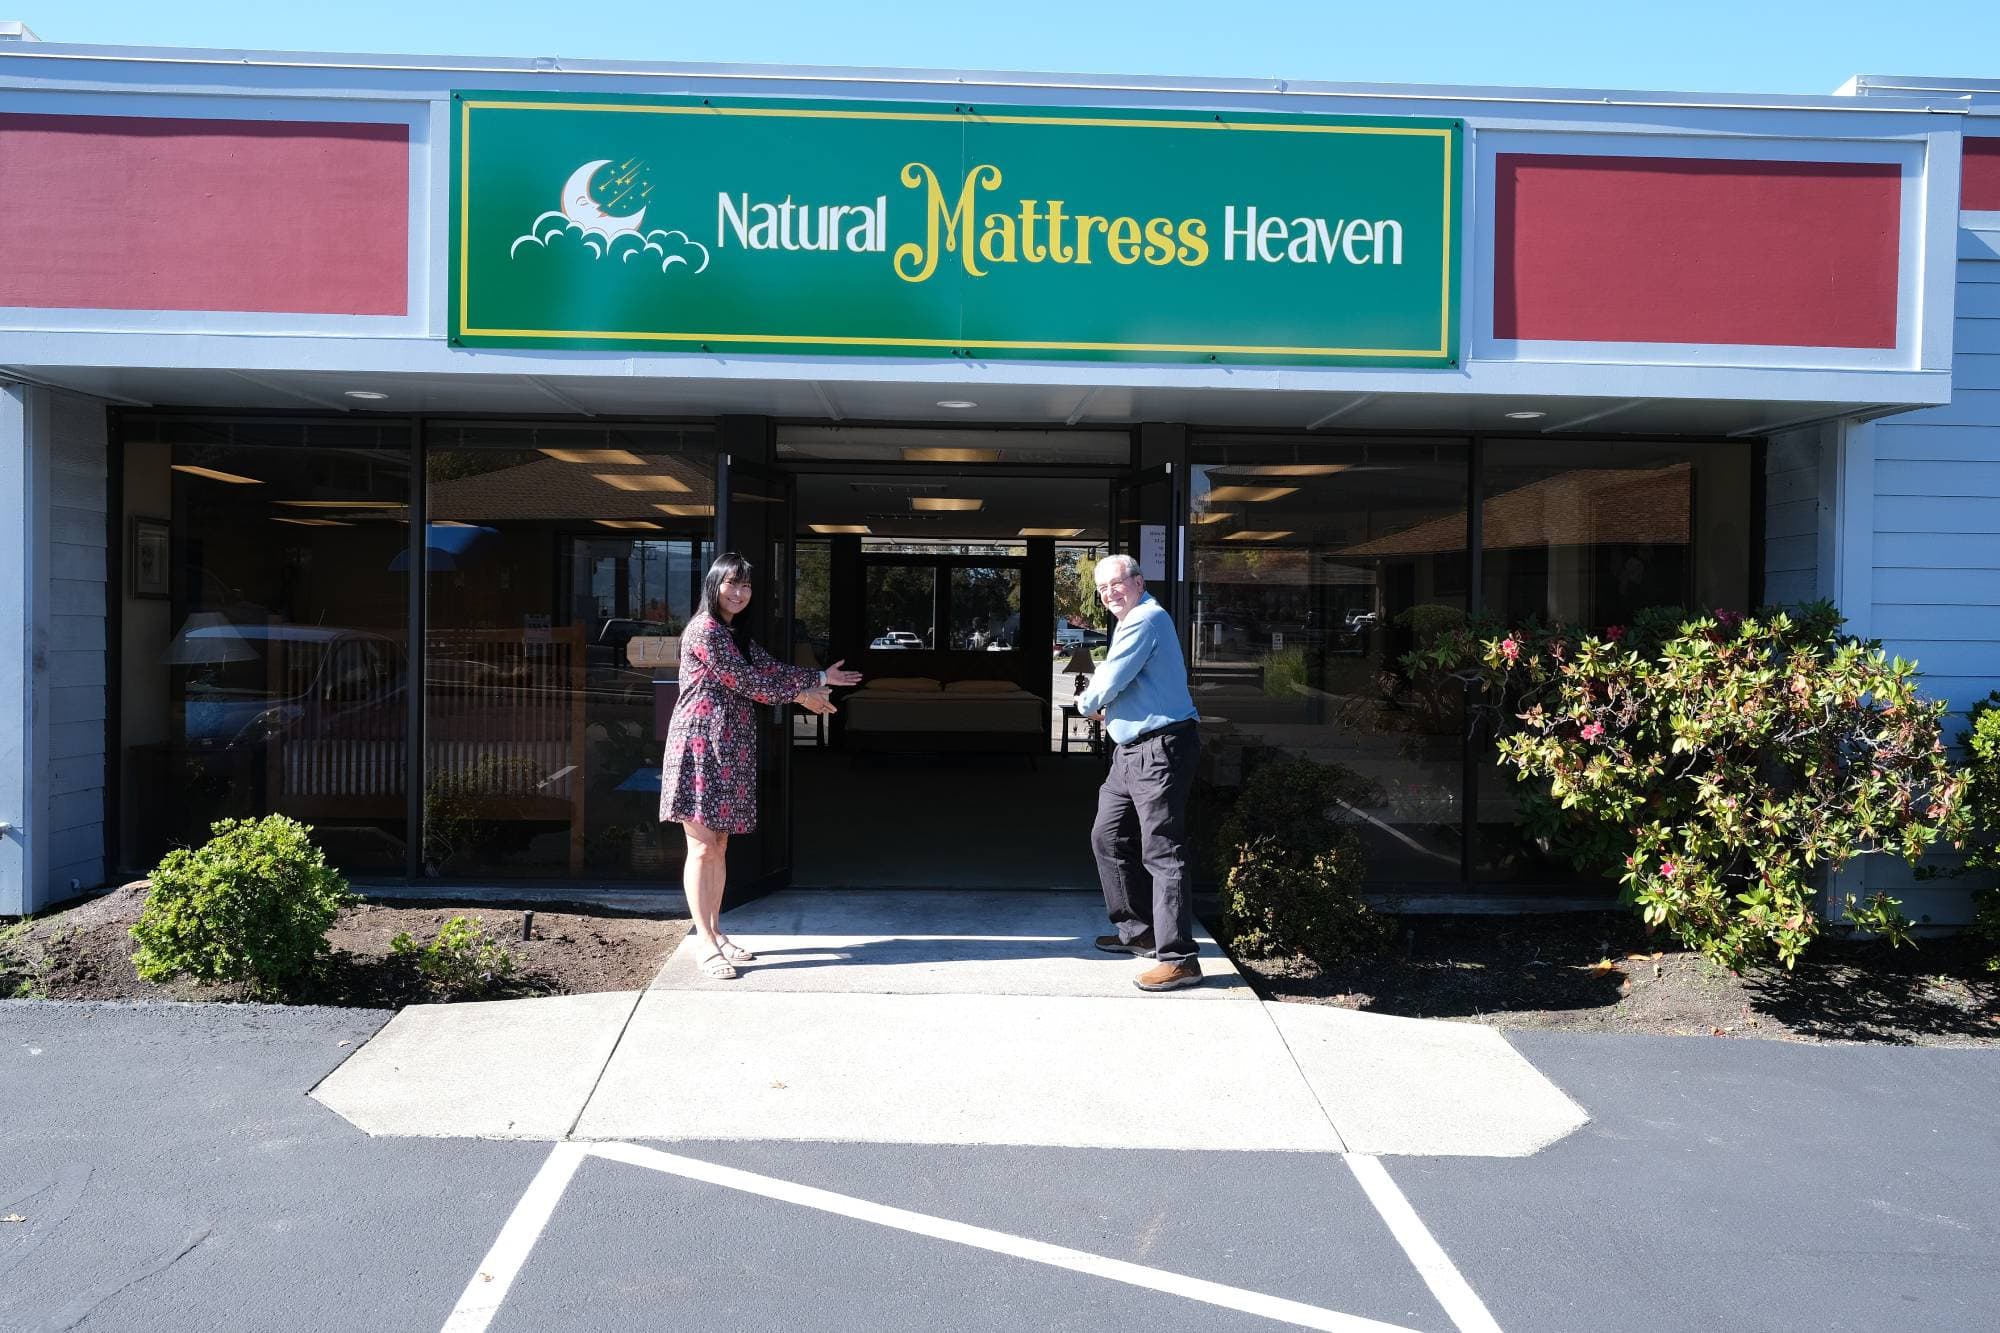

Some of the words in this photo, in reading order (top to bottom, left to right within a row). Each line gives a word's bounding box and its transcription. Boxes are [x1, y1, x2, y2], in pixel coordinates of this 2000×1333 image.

[717, 191, 887, 252] Natural
[893, 162, 1209, 283] Mattress
[1223, 205, 1403, 265] Heaven
